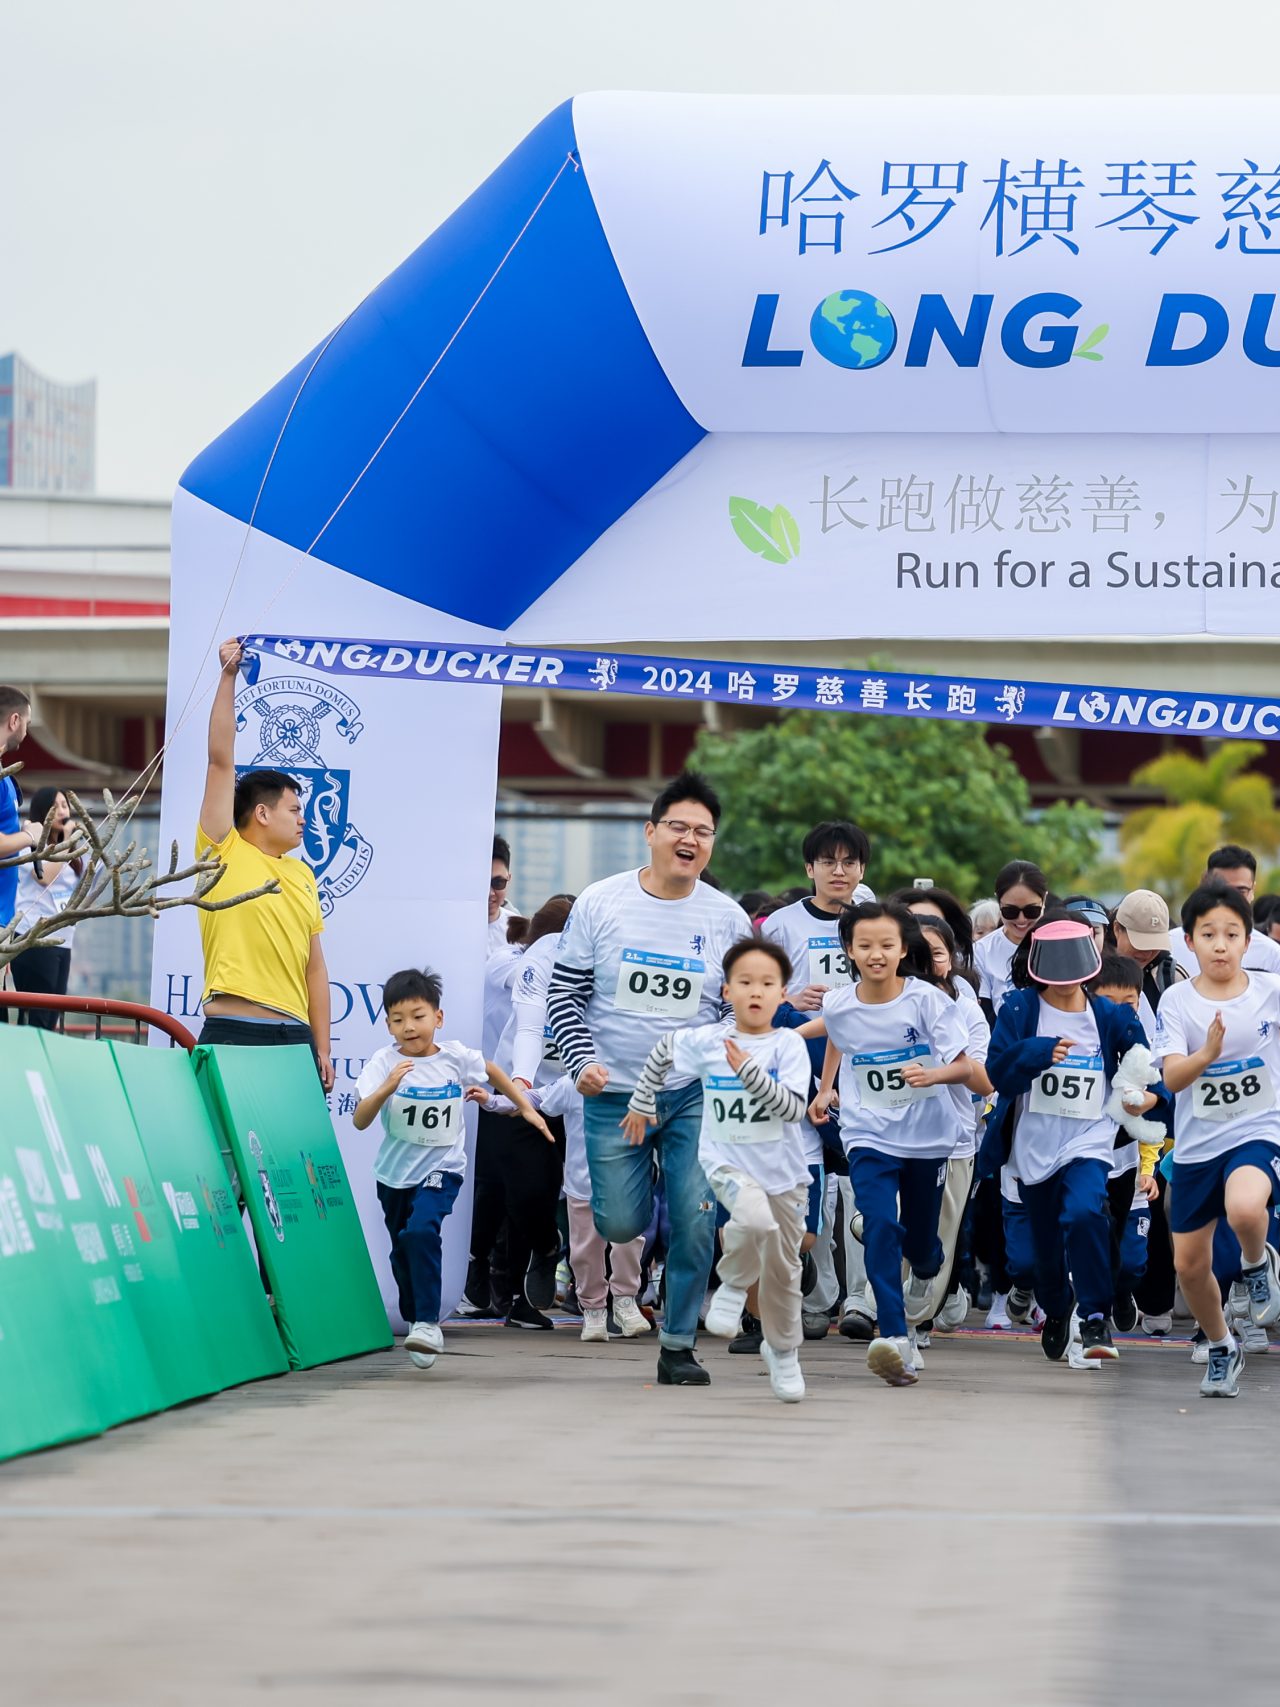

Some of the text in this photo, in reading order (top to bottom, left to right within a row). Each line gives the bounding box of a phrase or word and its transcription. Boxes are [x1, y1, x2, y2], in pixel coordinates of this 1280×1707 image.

[741, 290, 1083, 370] LONG
[897, 553, 978, 588] Run
[994, 550, 1055, 588] for
[1069, 561, 1090, 588] a
[380, 648, 563, 686] DUCKER
[261, 680, 313, 697] FORTUNA
[314, 684, 354, 717] DOMUS
[642, 667, 976, 715] 2024 哈罗慈善长跑
[1052, 690, 1179, 728] LONG
[334, 846, 370, 894] FIDELIS
[818, 953, 851, 975] 13
[629, 971, 692, 1000] 039
[1041, 1073, 1096, 1101] 057
[1199, 1074, 1260, 1107] 288
[402, 1104, 452, 1130] 161
[712, 1097, 770, 1124] 042
